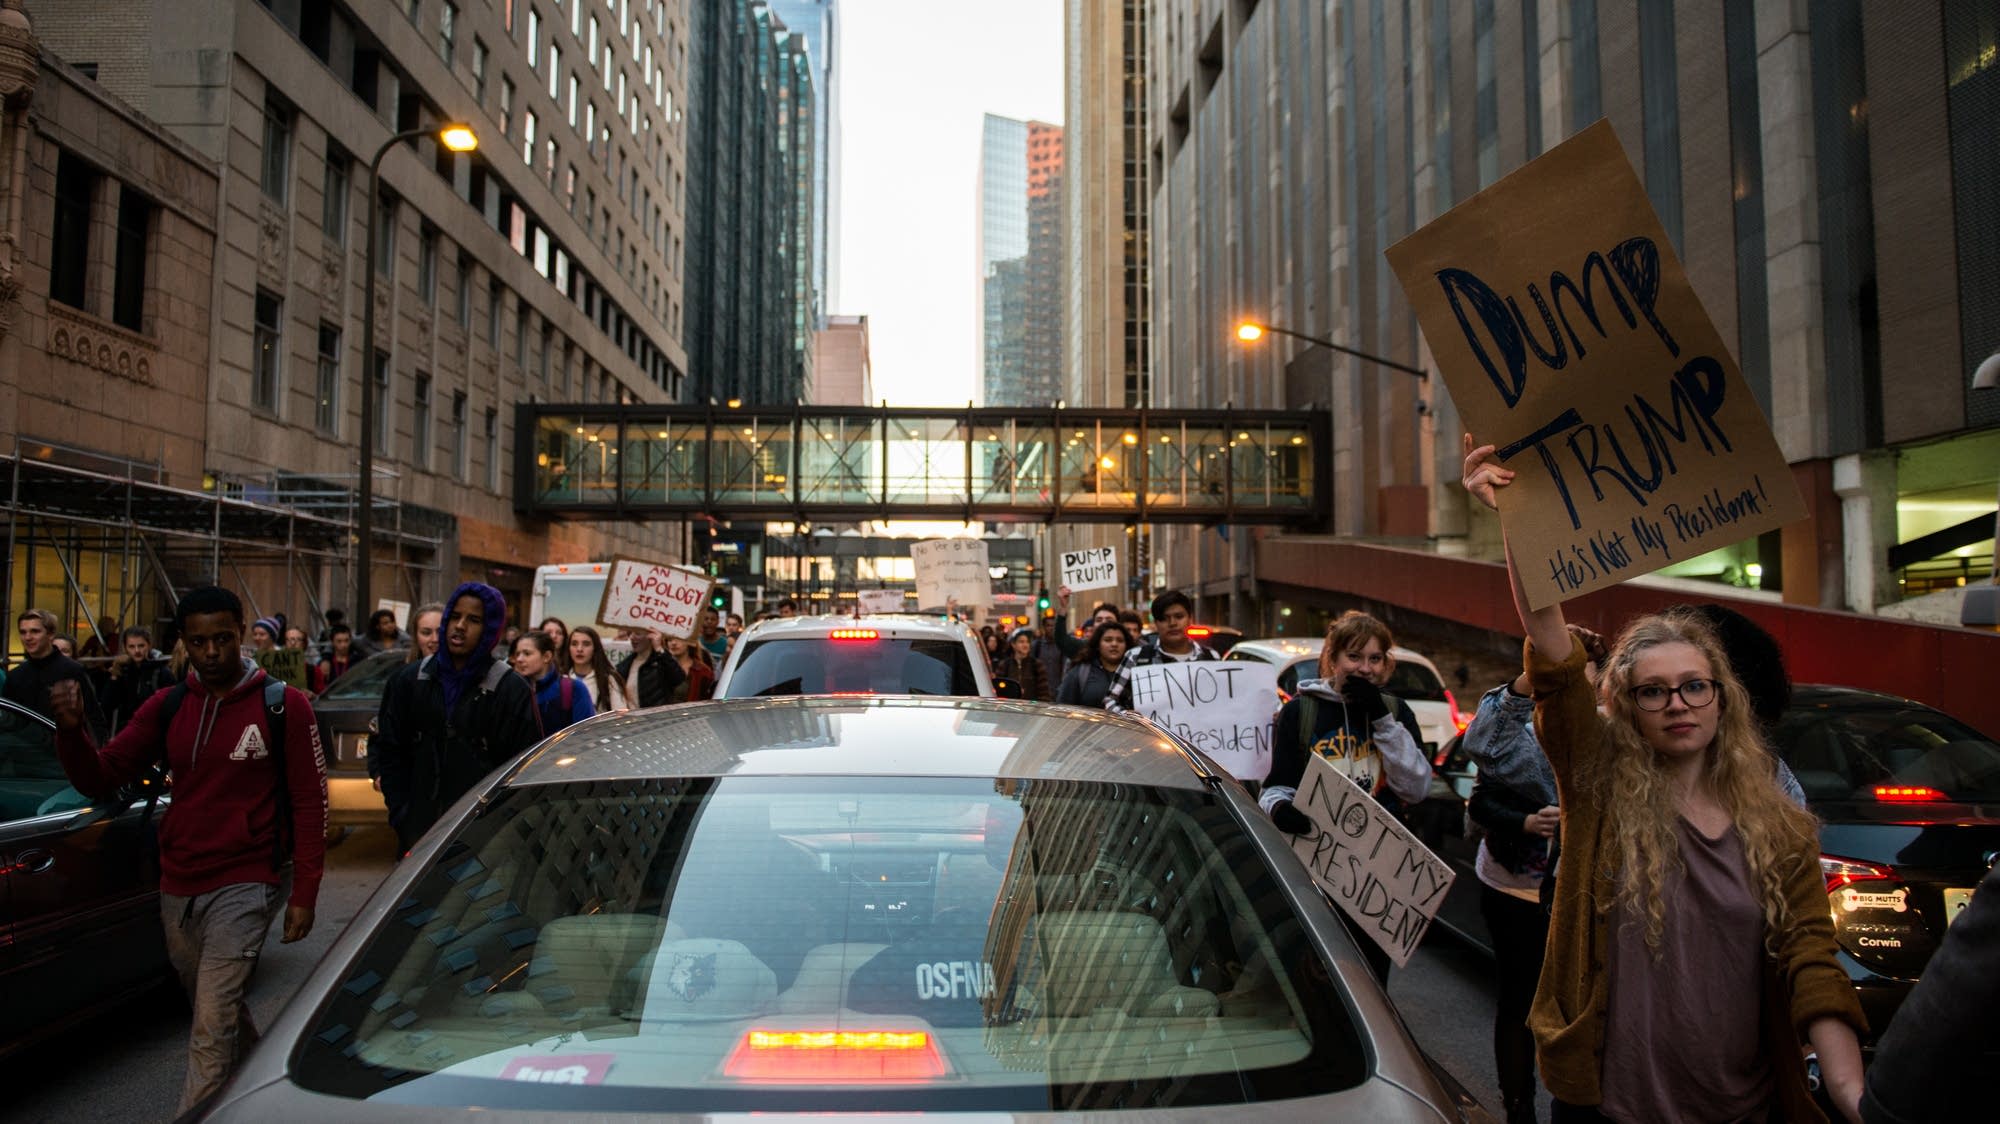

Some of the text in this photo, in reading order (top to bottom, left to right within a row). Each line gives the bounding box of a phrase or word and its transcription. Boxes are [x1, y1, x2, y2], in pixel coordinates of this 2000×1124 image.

[1434, 237, 1680, 408] DUMP
[1495, 356, 1733, 530] TRUMP
[1065, 548, 1111, 567] DUMP
[1589, 529, 1632, 575] Not
[1632, 516, 1671, 560] My
[631, 574, 705, 606] APOLOGY
[650, 566, 671, 578] AN
[1064, 563, 1114, 584] TRUMP
[629, 605, 693, 631] ORDER!
[654, 598, 669, 608] IN
[1132, 665, 1244, 710] #NOT
[1308, 773, 1402, 861] NOT
[1291, 815, 1431, 958] PRESIDENT
[1858, 936, 1902, 948] Corwin
[916, 960, 998, 1001] OSFNA
